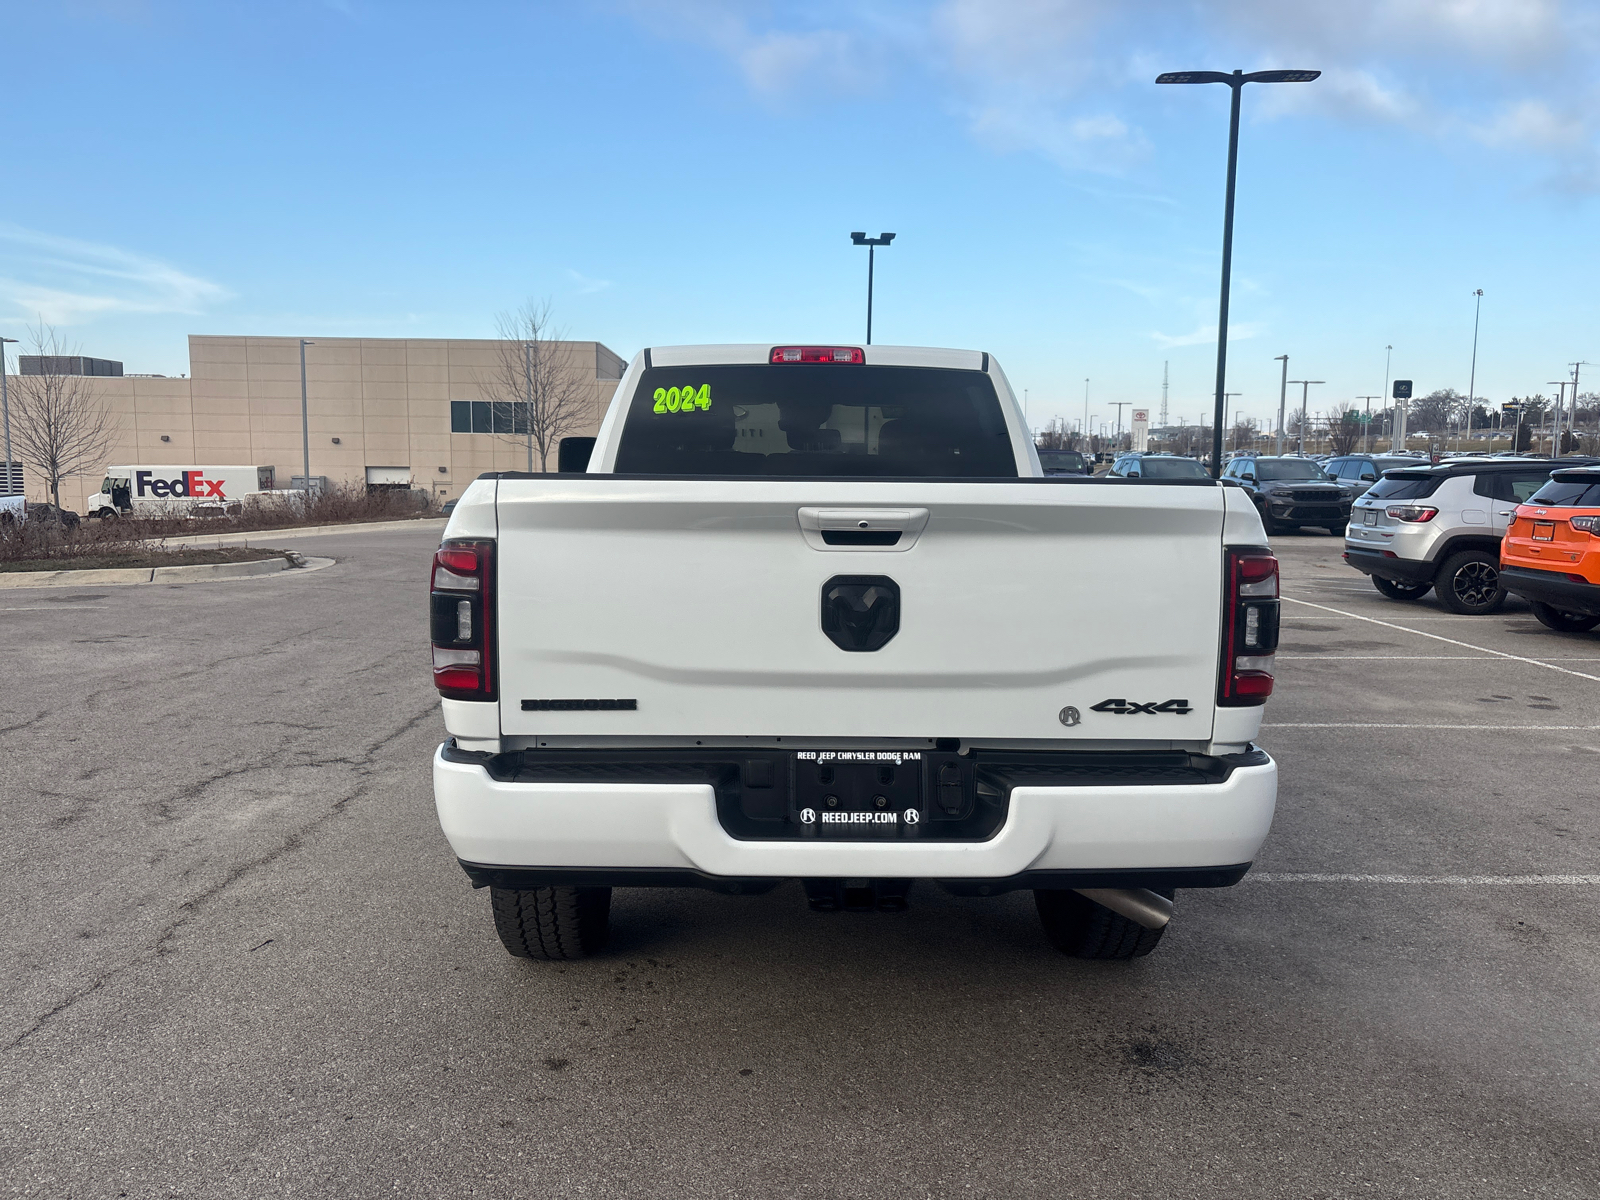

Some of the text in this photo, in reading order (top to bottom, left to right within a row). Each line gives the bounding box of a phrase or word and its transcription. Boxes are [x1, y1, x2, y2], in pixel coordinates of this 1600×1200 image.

[653, 383, 712, 415] 2024
[735, 428, 763, 438] ITI
[136, 470, 227, 498] FedEx
[1089, 698, 1194, 715] 4x4
[797, 752, 921, 760] REED JEEP CHRYSLER DODGE RAM
[822, 812, 897, 823] REEDJEEP.COM
